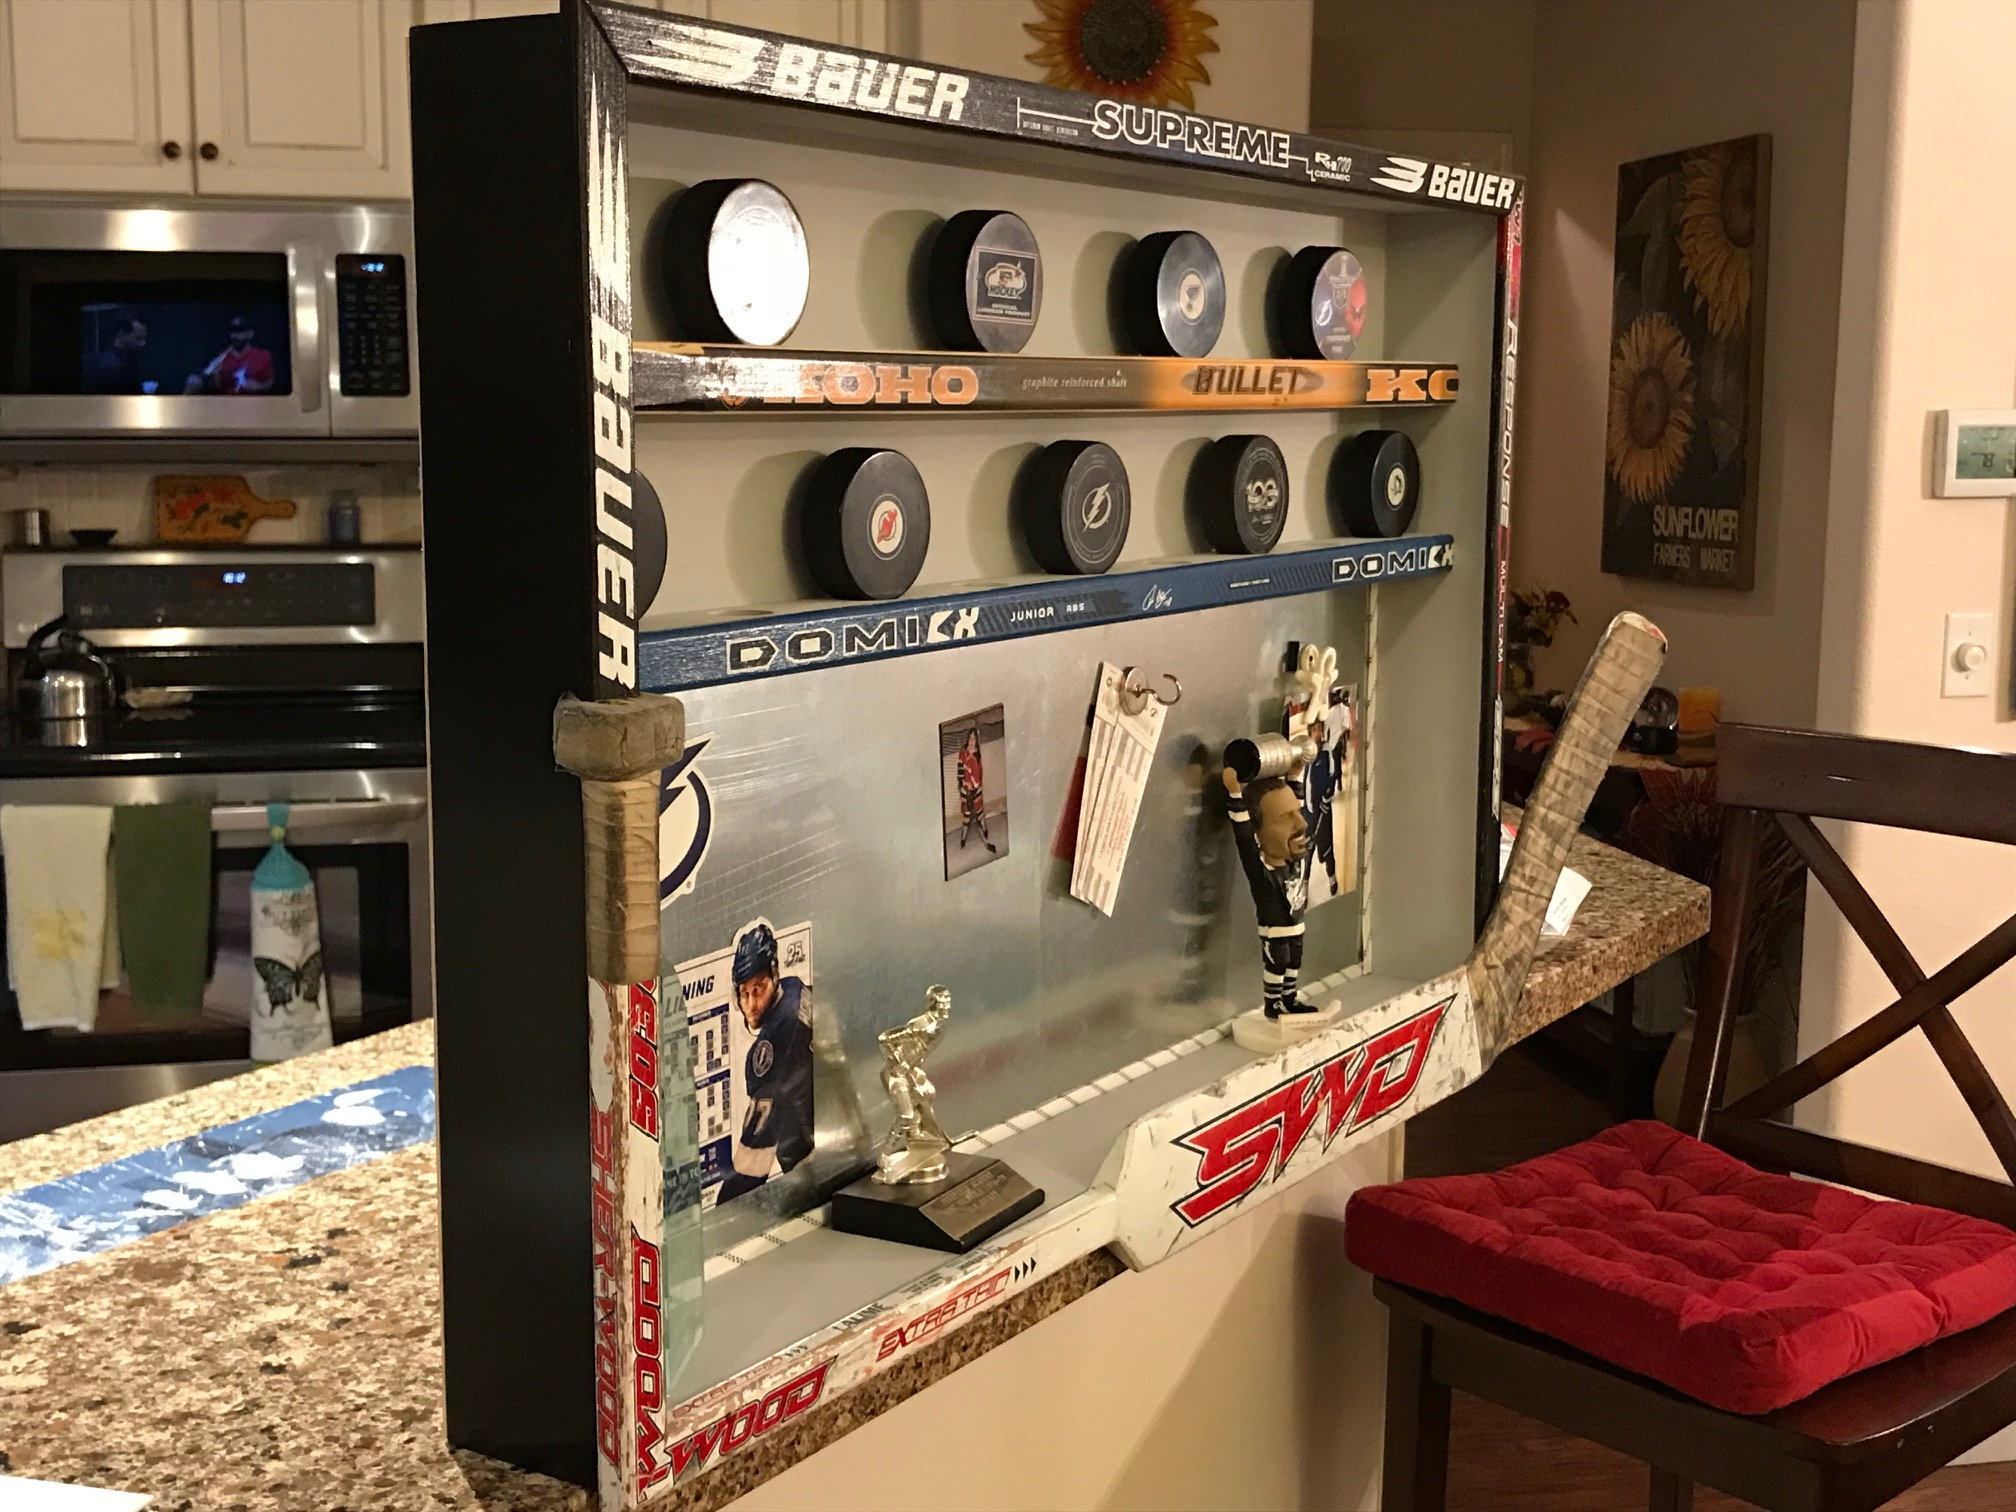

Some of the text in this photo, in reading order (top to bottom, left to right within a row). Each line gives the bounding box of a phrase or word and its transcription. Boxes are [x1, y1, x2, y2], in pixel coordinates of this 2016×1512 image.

[1092, 99, 1291, 168] SUPREME
[1314, 170, 1351, 182] CERAMIC
[1022, 374, 1128, 391] graphite reinforced shaft
[1192, 365, 1305, 396] BULLET
[1500, 318, 1517, 527] RESPONSE
[1652, 504, 1739, 542] SUNFLOWER
[1699, 546, 1736, 572] MARKET
[1010, 606, 1055, 622] JUNIOR
[875, 1299, 957, 1363] EXTRA
